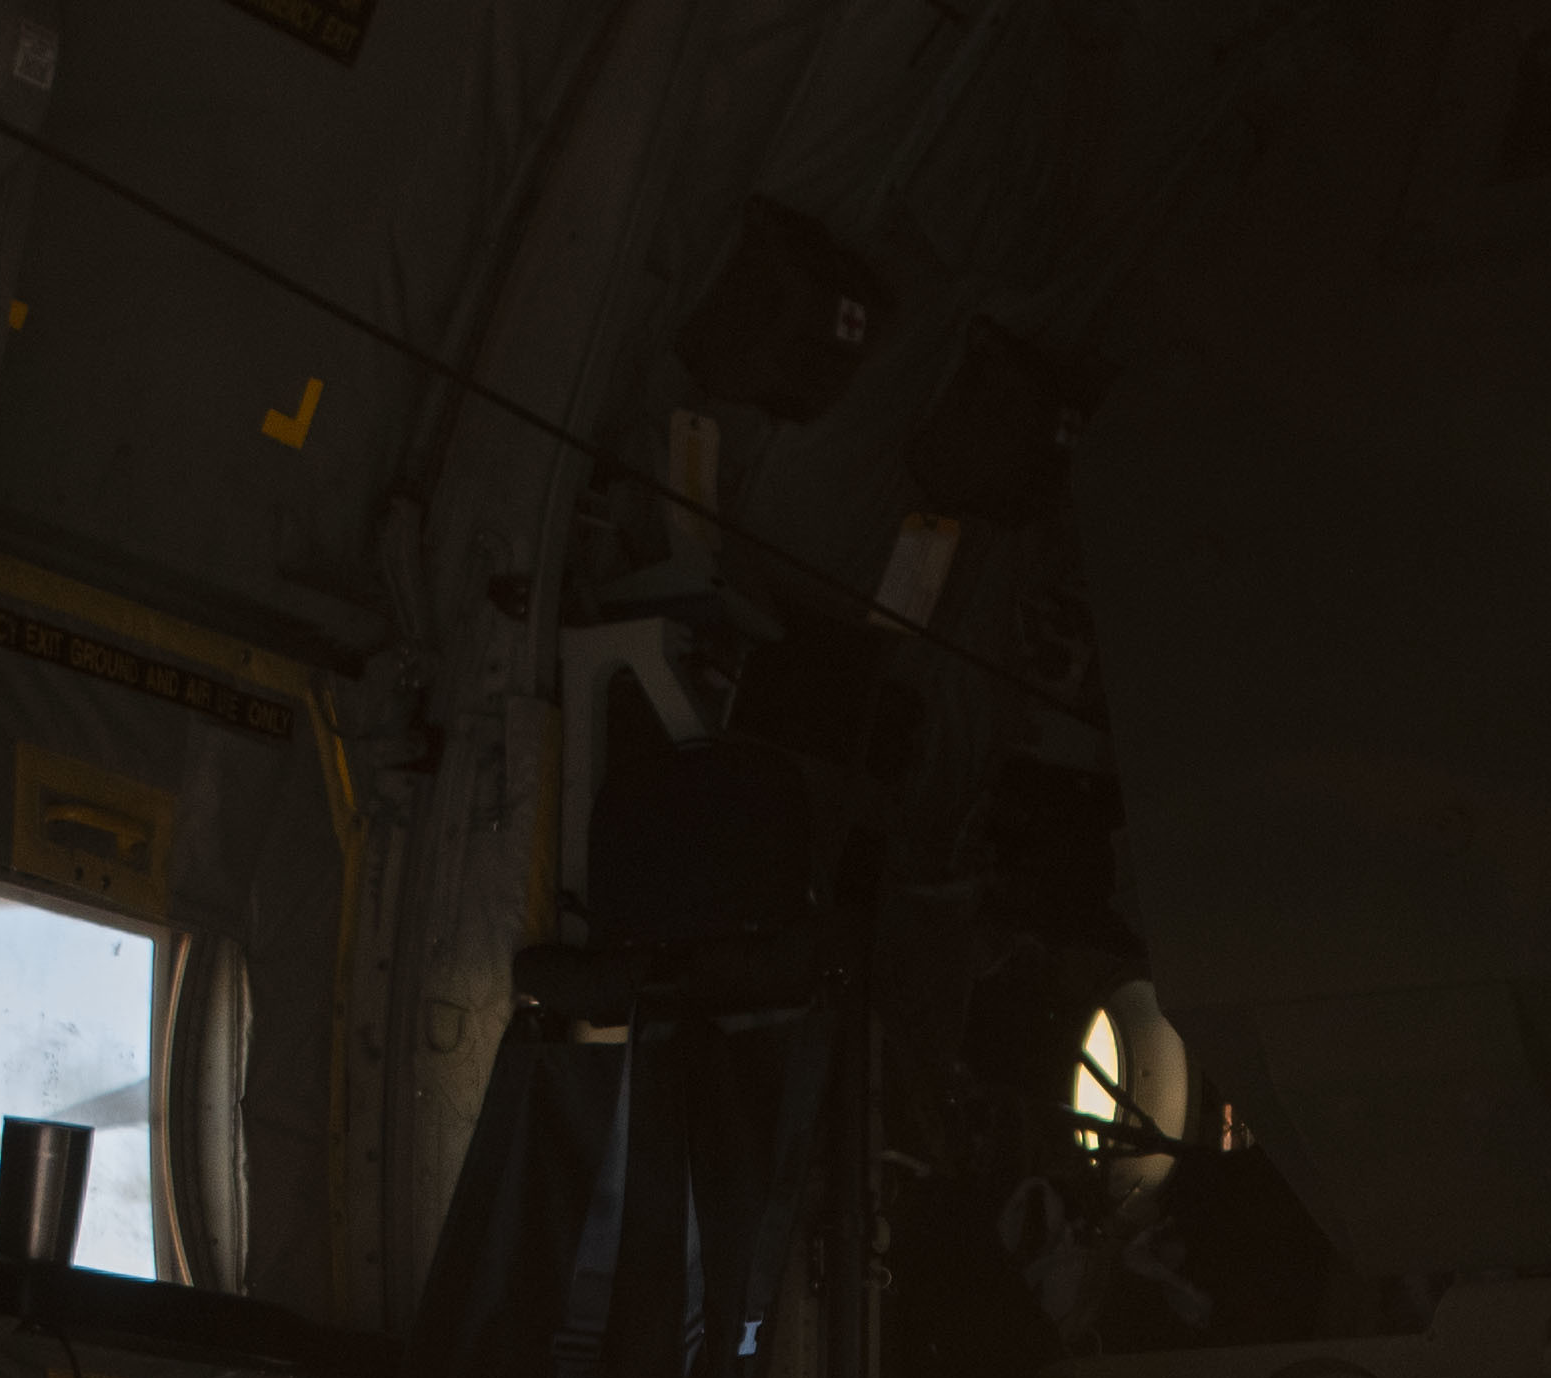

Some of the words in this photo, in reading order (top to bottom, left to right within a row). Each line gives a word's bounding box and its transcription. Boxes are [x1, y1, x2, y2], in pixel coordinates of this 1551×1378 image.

[25, 622, 64, 658] EXIT
[68, 638, 139, 684] GROUND
[145, 665, 179, 697] AND
[184, 678, 212, 707] AIR
[247, 700, 291, 733] ONLY
